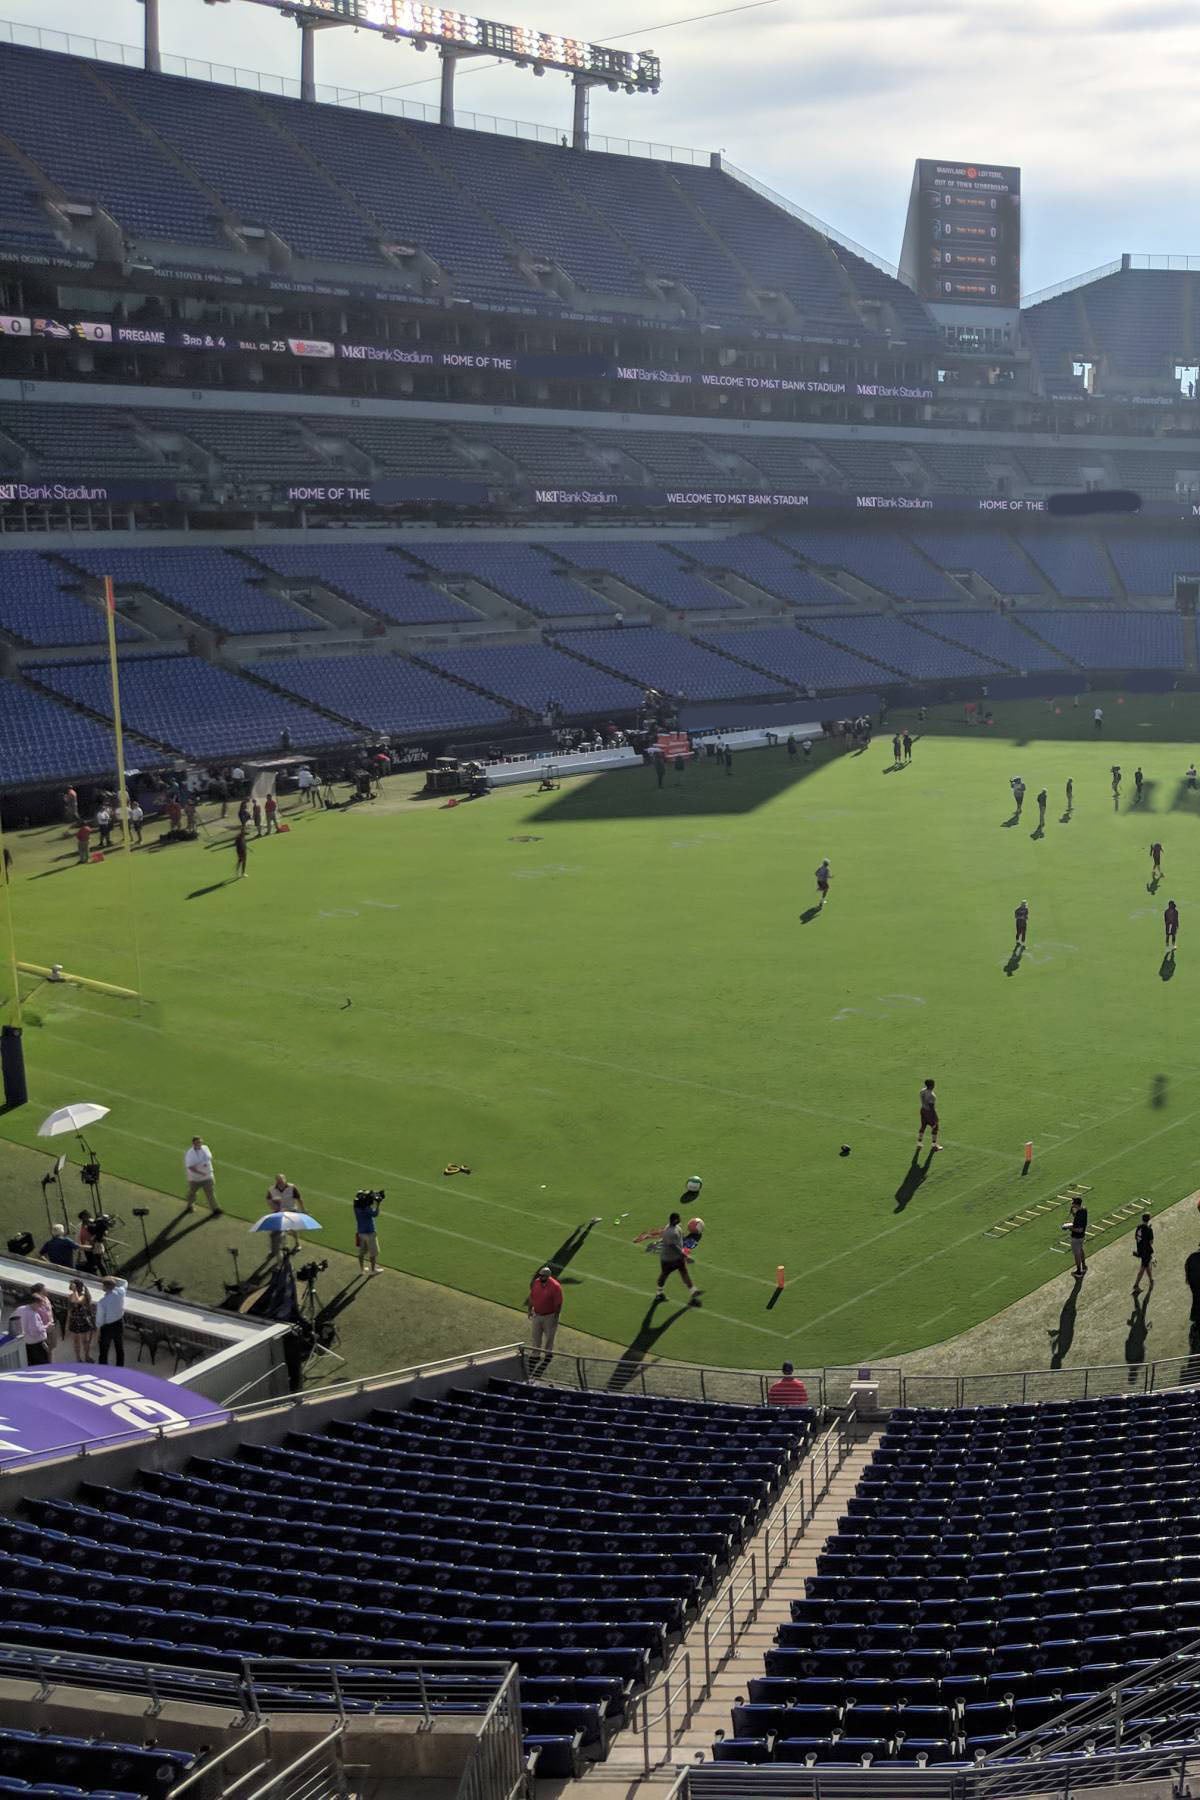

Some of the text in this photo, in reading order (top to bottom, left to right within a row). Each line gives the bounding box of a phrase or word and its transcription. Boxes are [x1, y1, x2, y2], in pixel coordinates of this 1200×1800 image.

[11, 320, 21, 333] 0
[94, 326, 103, 339] 0
[119, 328, 165, 343] PREGAME
[183, 334, 226, 347] 3RD & 4
[272, 341, 286, 352] 25
[342, 345, 367, 359] M&T
[368, 346, 393, 361] Bank
[394, 347, 433, 363] Stadium
[443, 354, 512, 370] HOME OF THE
[617, 367, 639, 380] M&T
[639, 368, 658, 381] Bank
[702, 375, 845, 393] WELCOME TO M&T BANK STADIUM
[18, 484, 52, 499] Bank
[53, 484, 107, 499] Stadium
[289, 487, 371, 500] HOME OF THE
[535, 490, 618, 503] M&T Bank Stadium
[667, 493, 809, 505] WELCOME TO M&T BANK STADIUM
[856, 496, 877, 507] M&T
[877, 496, 898, 508] Bank
[979, 500, 1044, 511] HOME OF THE
[0, 1370, 191, 1434] GEIC
